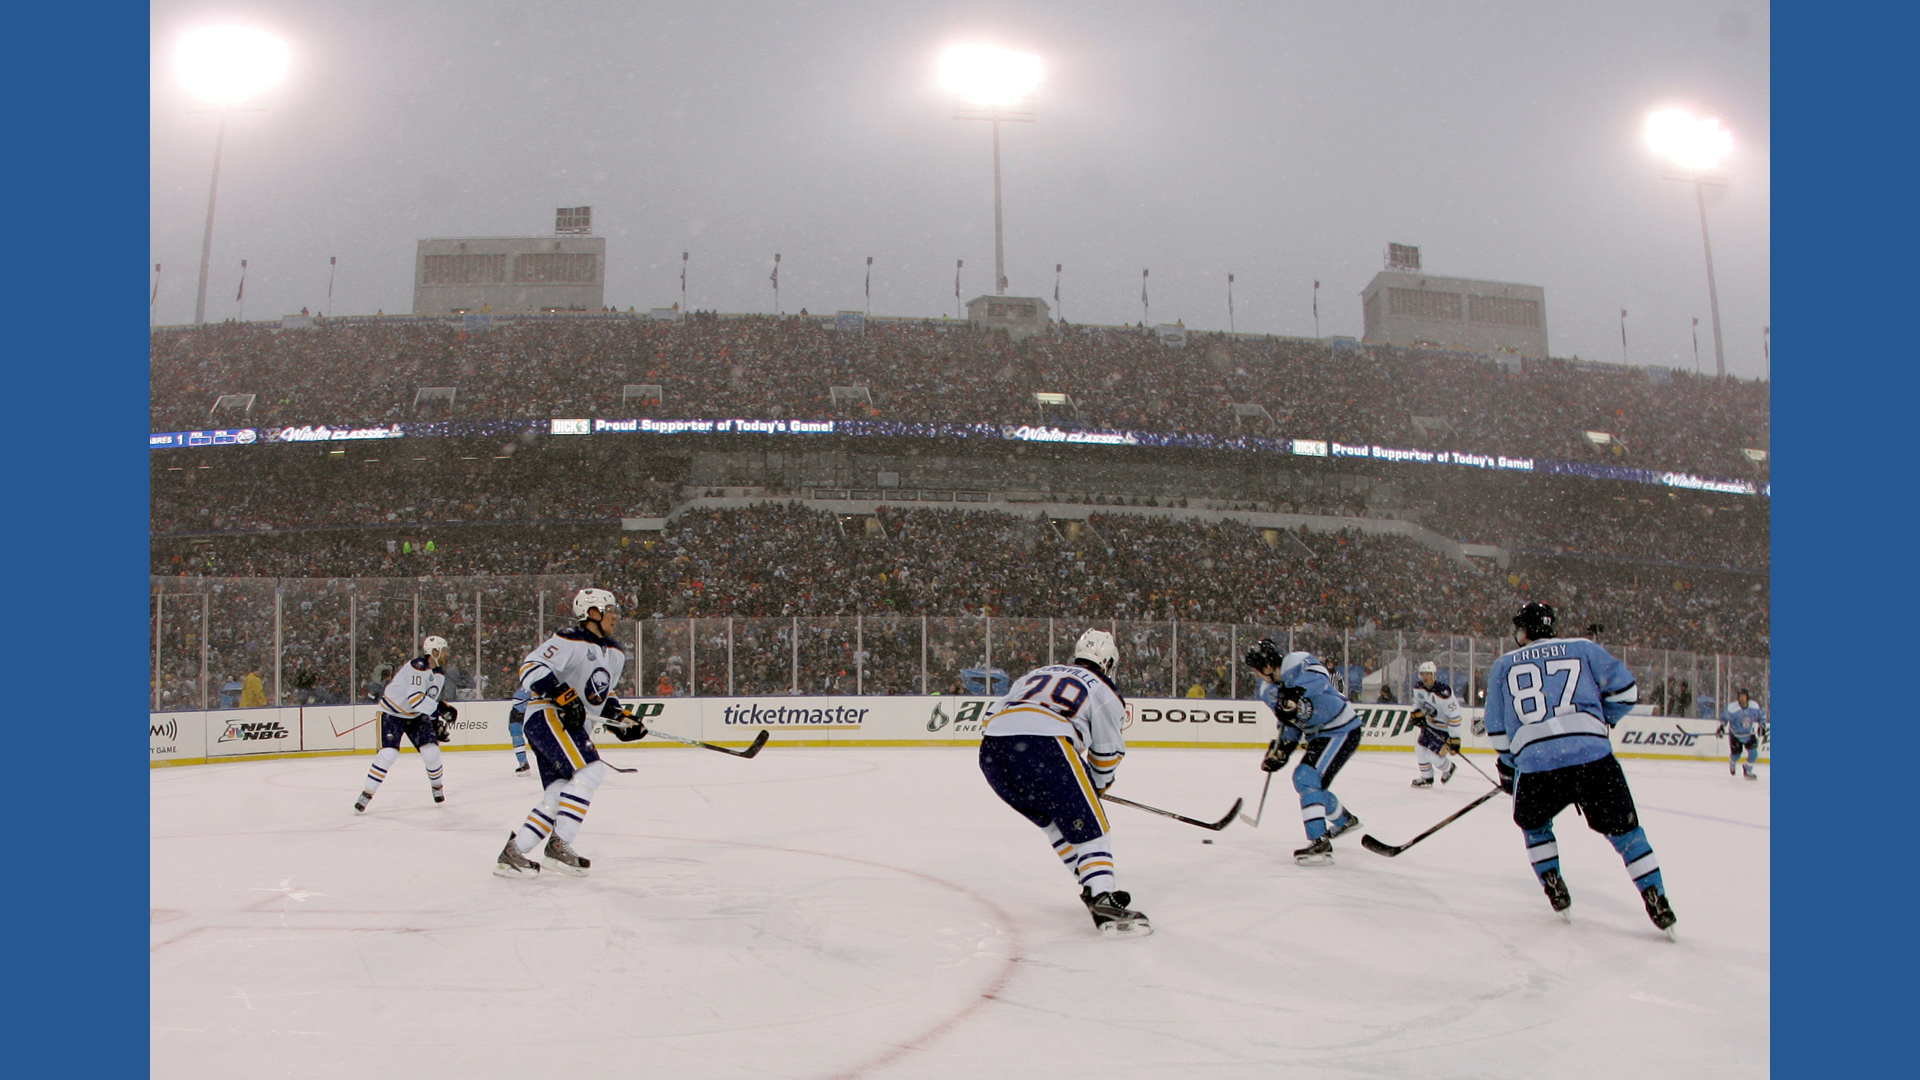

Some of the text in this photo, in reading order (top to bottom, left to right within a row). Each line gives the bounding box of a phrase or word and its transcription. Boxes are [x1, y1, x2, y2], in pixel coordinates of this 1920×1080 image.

[280, 425, 390, 442] Winter CLASSIC
[596, 419, 637, 431] Proud
[641, 419, 713, 433] Supporter
[717, 419, 732, 431] of
[735, 419, 786, 434] Today's
[790, 420, 834, 432] Game!
[177, 434, 184, 445] 1
[1015, 425, 1067, 442] Winter
[1066, 432, 1124, 445] CLASSIC
[1331, 442, 1369, 456] Proud
[1372, 445, 1434, 462] Supporter
[1436, 451, 1450, 463] of
[1452, 452, 1495, 468] Today's
[1498, 456, 1535, 470] Game!
[543, 644, 559, 660] 5
[1512, 644, 1568, 663] CROSBY
[411, 674, 422, 686] 10
[1507, 658, 1581, 725] 87
[724, 703, 869, 725] ticketmaster
[1141, 709, 1257, 724] DODGE
[241, 722, 285, 732] NHL
[243, 730, 289, 741] NBC
[1621, 731, 1698, 747] CLASSIC
